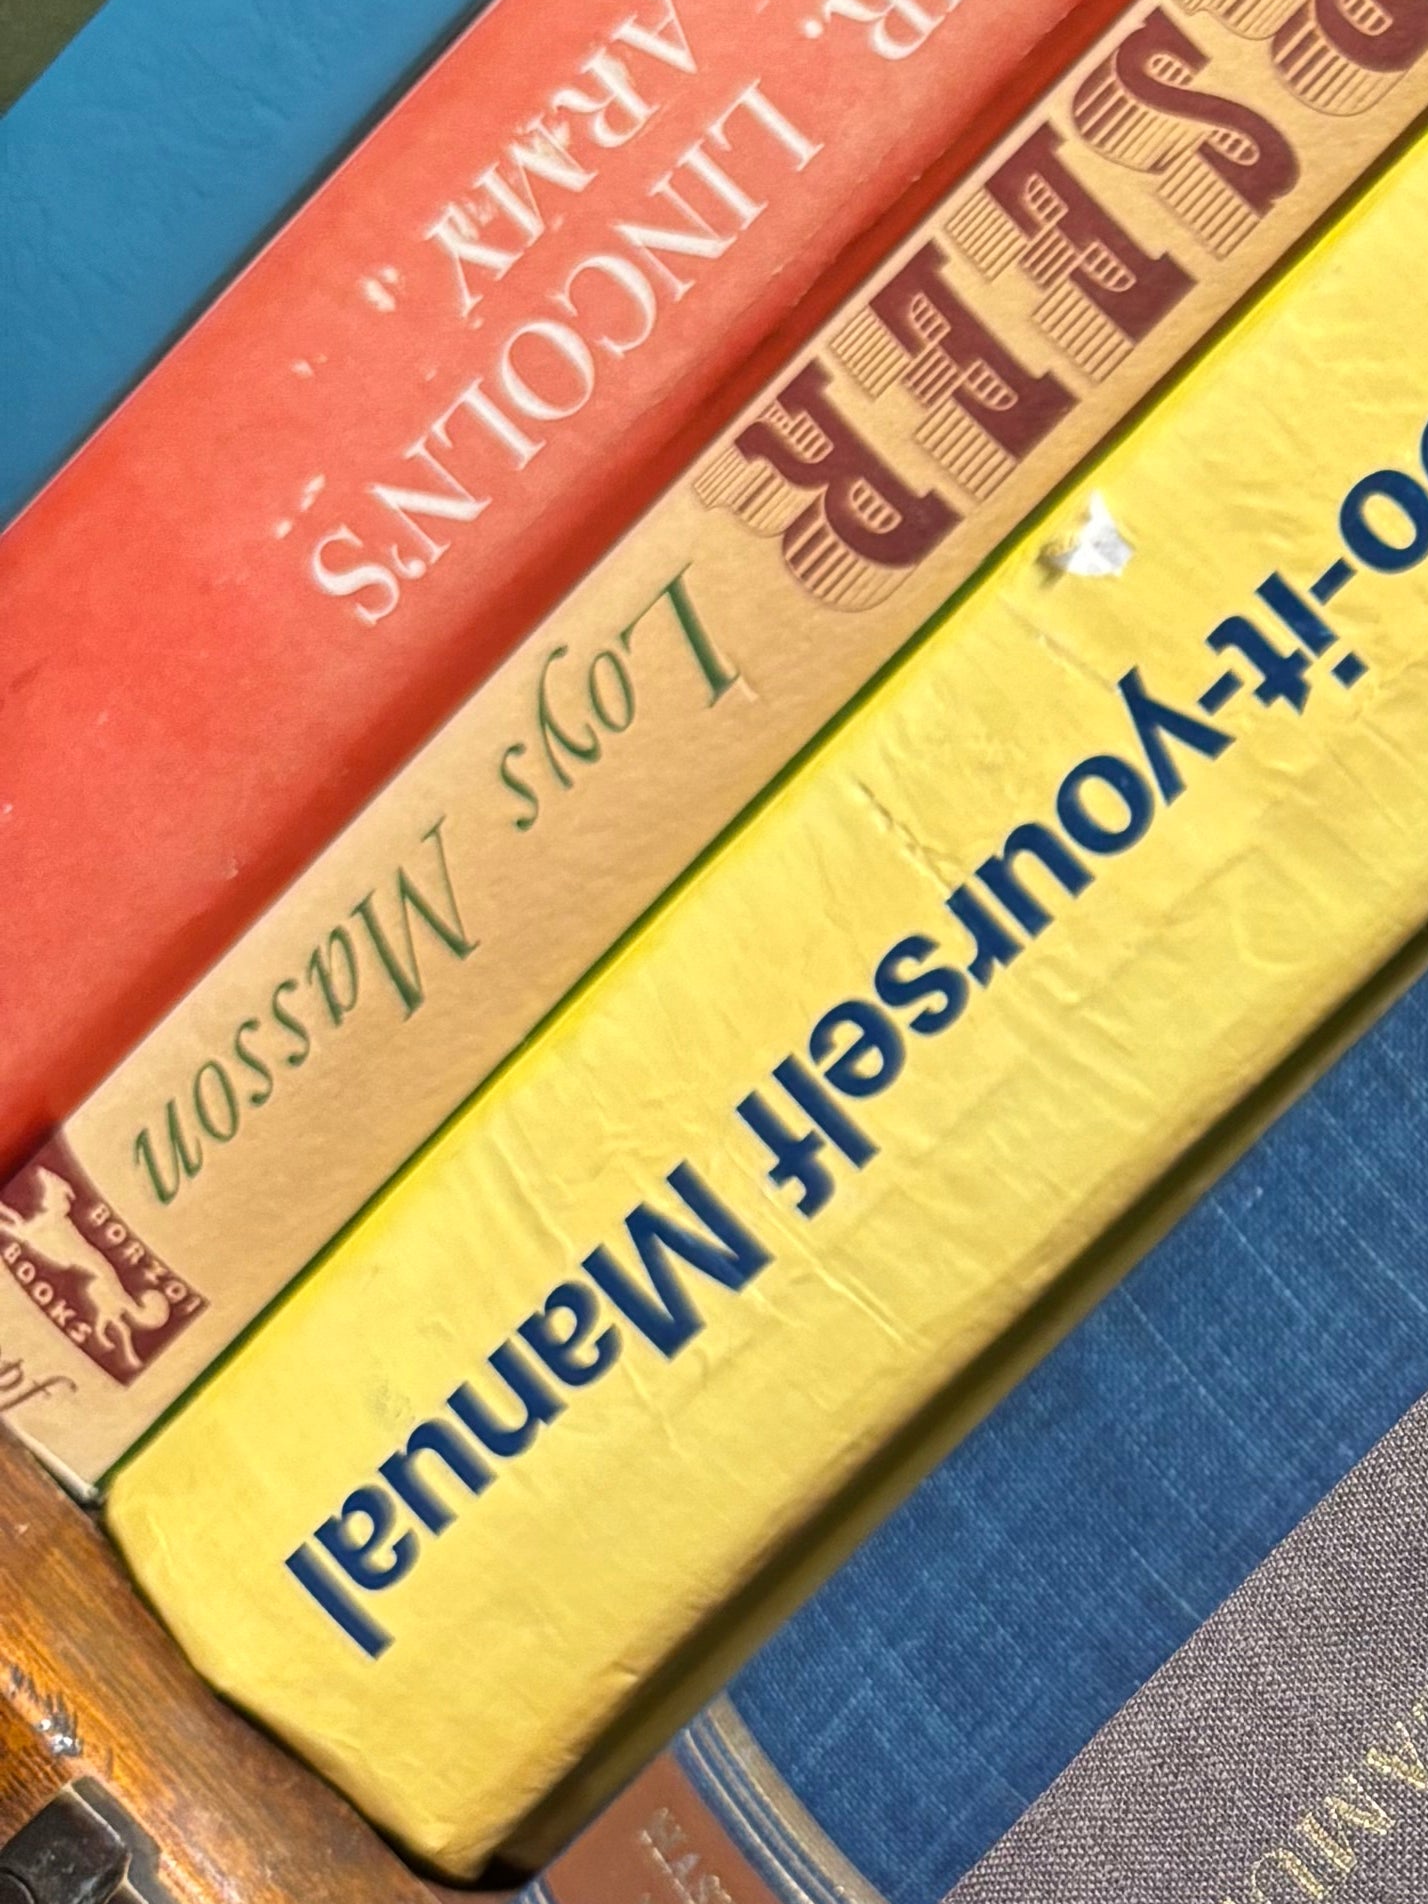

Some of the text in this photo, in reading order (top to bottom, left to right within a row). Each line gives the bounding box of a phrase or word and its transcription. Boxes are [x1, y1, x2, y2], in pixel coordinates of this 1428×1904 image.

[308, 80, 825, 626] LINCOLN'S
[131, 563, 743, 1205] Loys Masson
[3, 1242, 94, 1345] BOOKS
[87, 1201, 203, 1315] BORZOI
[282, 1160, 778, 1662] Manual
